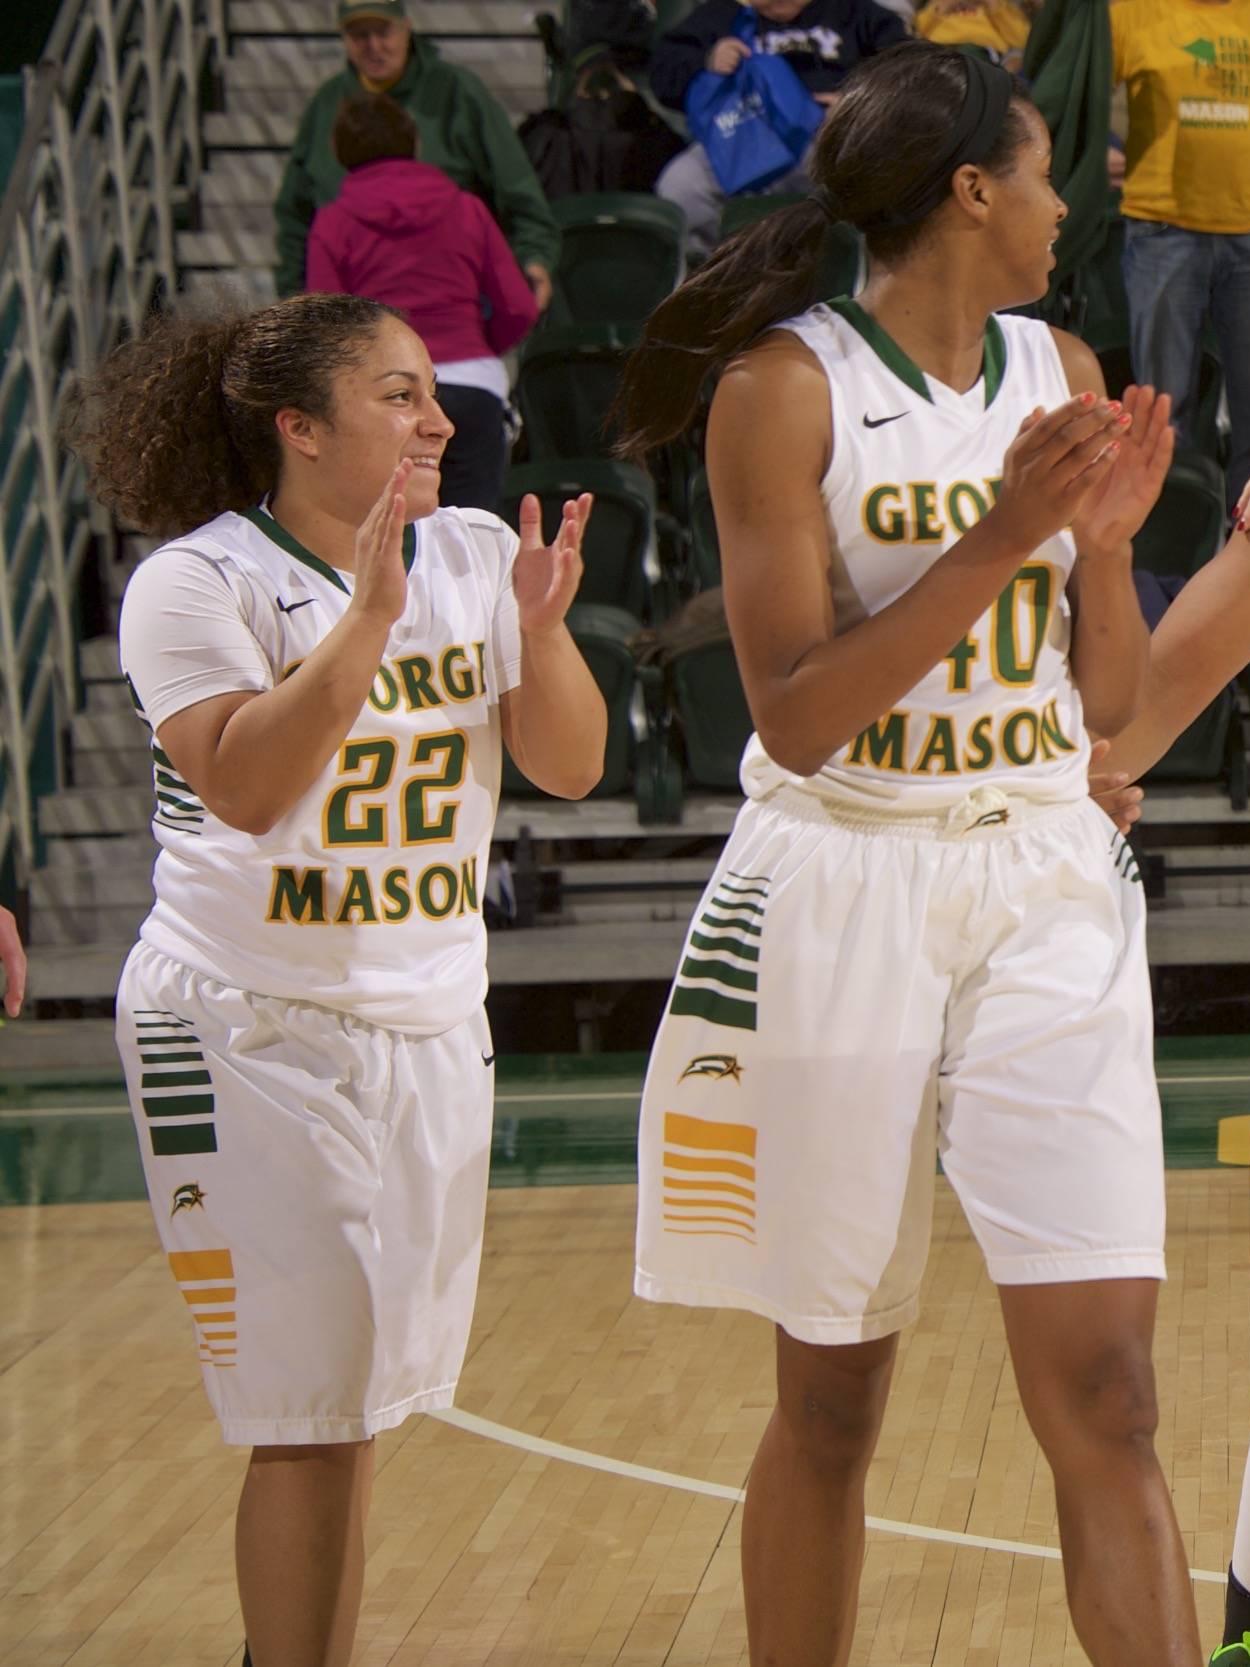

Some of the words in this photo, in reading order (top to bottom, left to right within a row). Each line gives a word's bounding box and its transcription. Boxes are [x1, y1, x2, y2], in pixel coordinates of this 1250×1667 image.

[863, 478, 1003, 544] GEO
[845, 698, 1077, 776] MASON
[322, 728, 468, 849] 22
[265, 857, 478, 925] MASON
